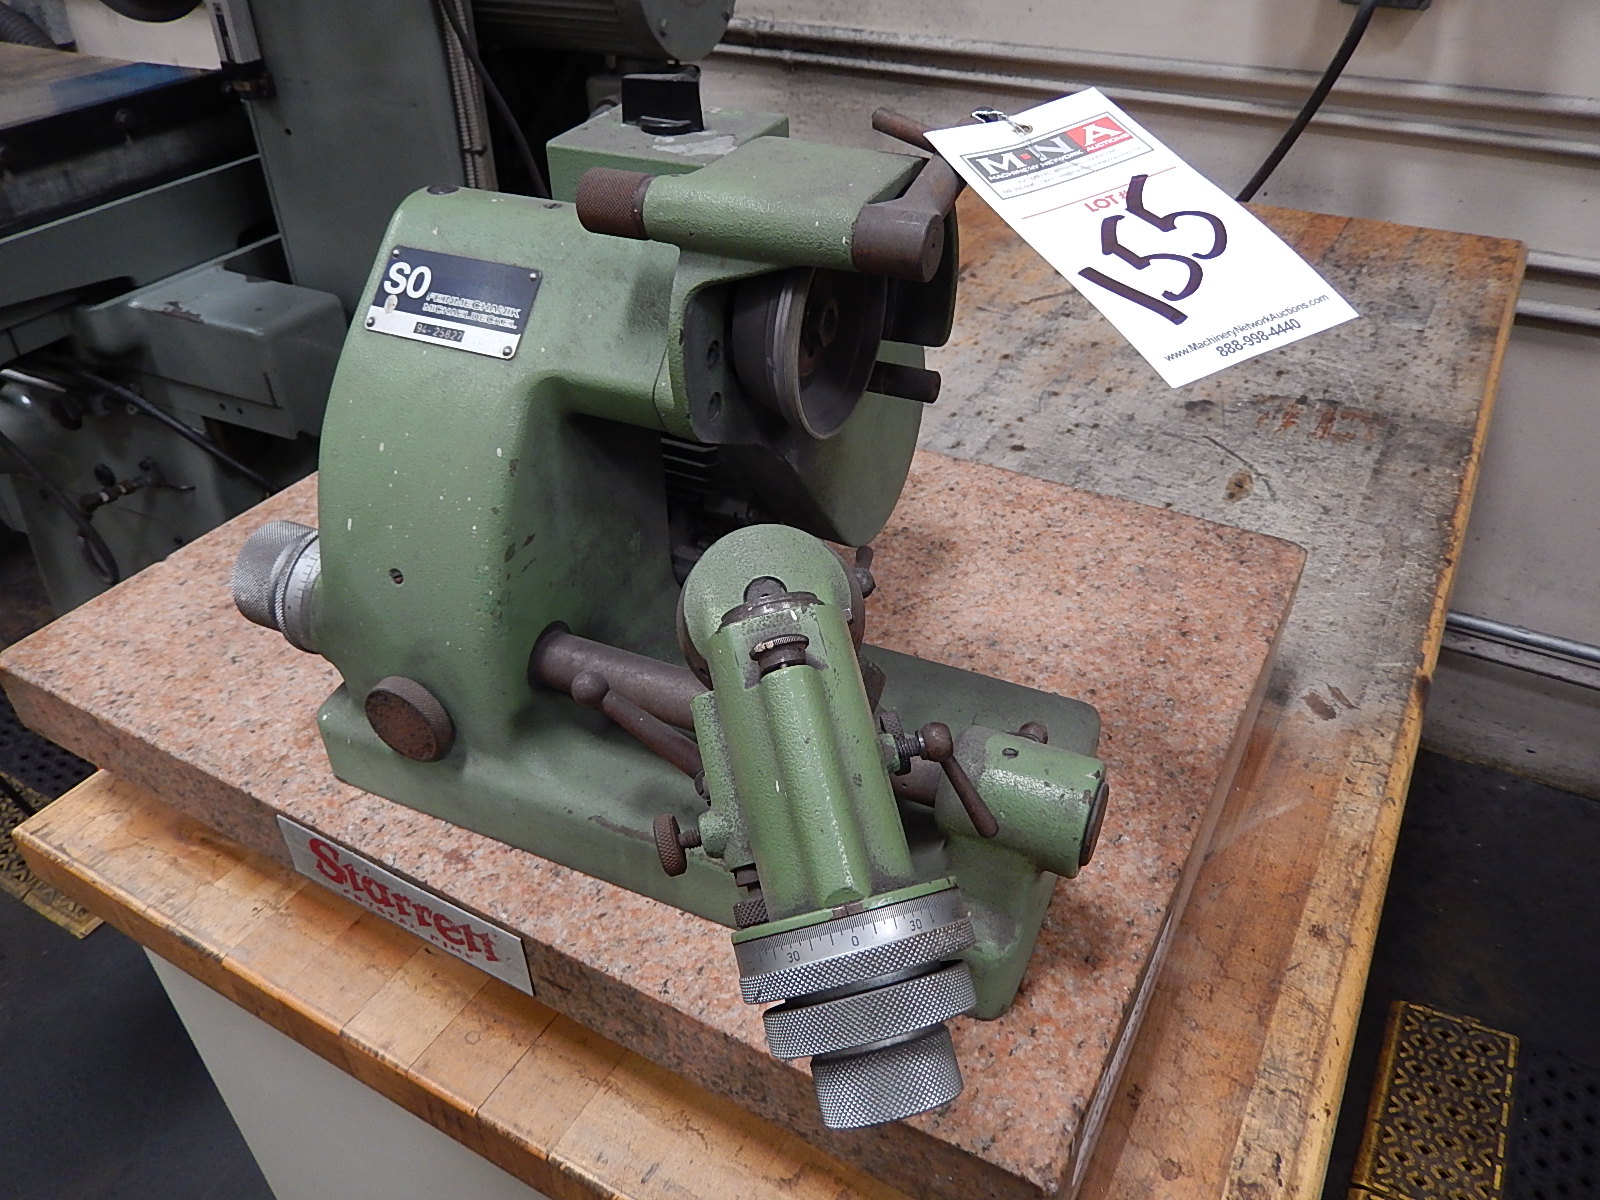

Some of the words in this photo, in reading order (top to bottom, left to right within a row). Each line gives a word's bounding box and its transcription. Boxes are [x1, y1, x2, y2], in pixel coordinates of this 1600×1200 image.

[1086, 132, 1131, 152] AUCTIONS
[1084, 195, 1119, 212] LOT
[1077, 174, 1228, 325] 155
[383, 261, 432, 299] SO
[421, 302, 470, 319] MICHAEL
[1164, 293, 1330, 362] www.MachineryNetworkAuctions.com
[1215, 318, 1302, 357] 888-998-4440
[786, 949, 801, 964] 30
[851, 935, 860, 947] 0
[910, 918, 923, 932] 30
